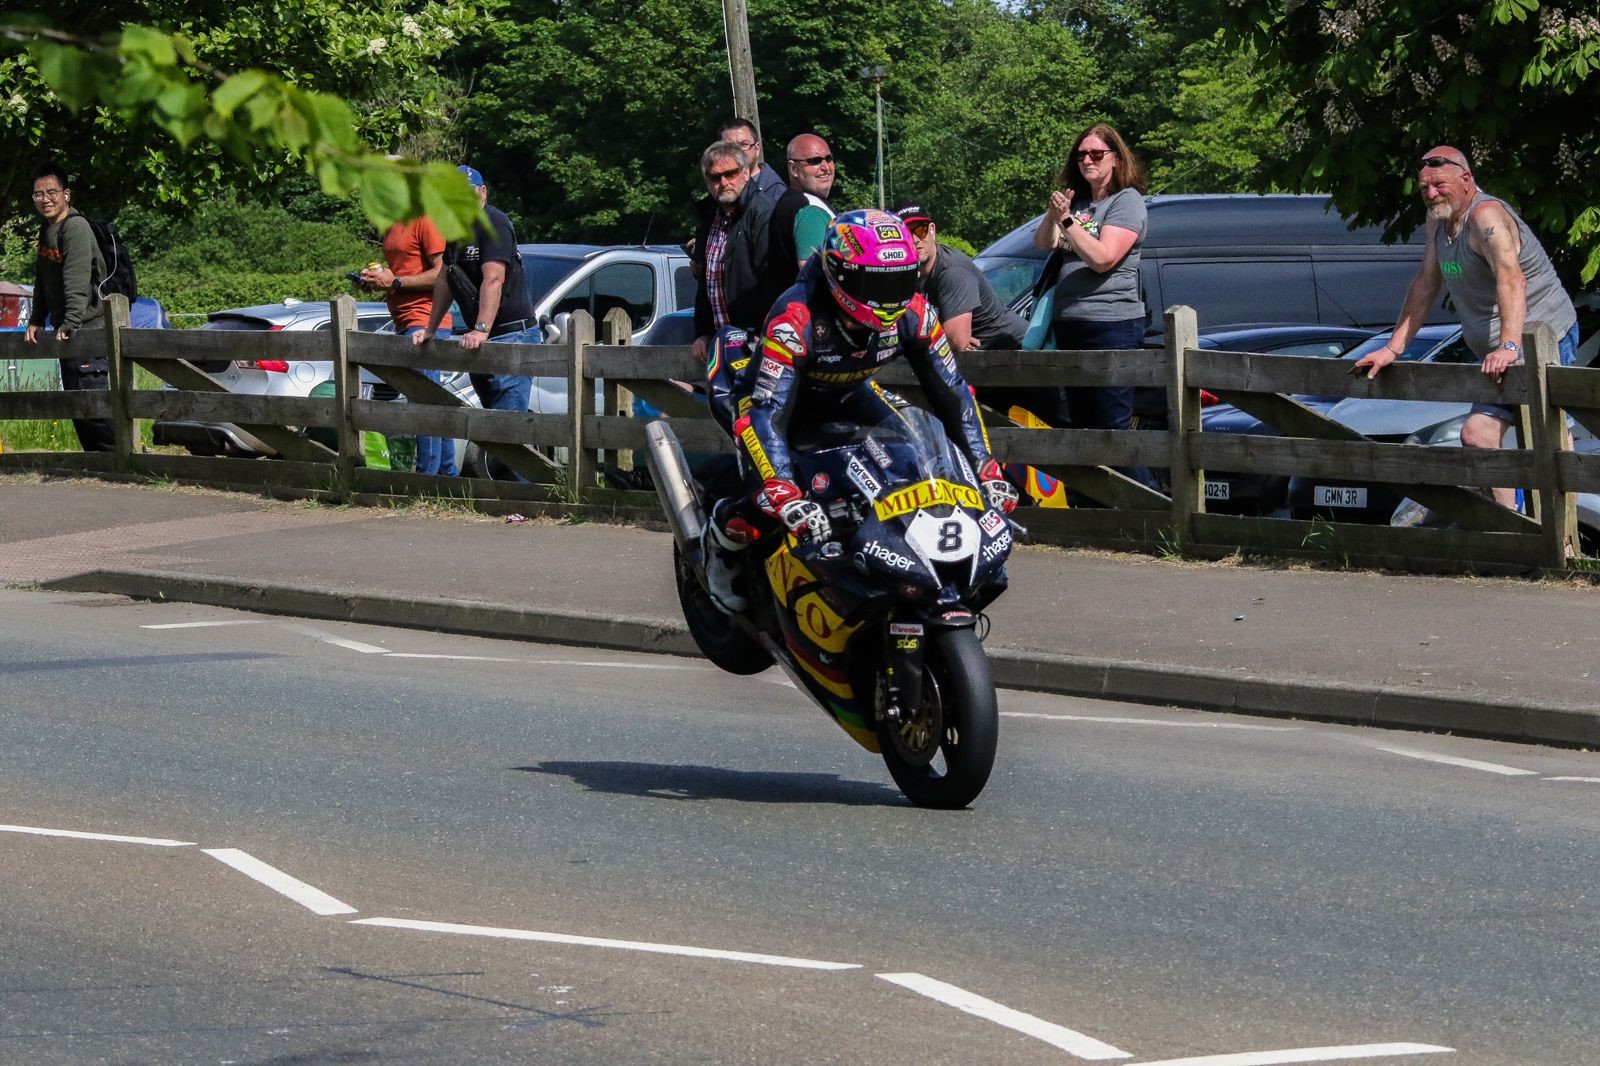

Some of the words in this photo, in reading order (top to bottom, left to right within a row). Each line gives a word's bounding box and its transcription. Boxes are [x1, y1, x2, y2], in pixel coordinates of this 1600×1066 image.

[762, 360, 781, 373] NGK
[742, 428, 774, 478] MILENCO
[882, 480, 980, 516] MILENCO
[1324, 489, 1343, 503] GMN
[1345, 490, 1358, 504] 3R
[937, 520, 964, 552] 8
